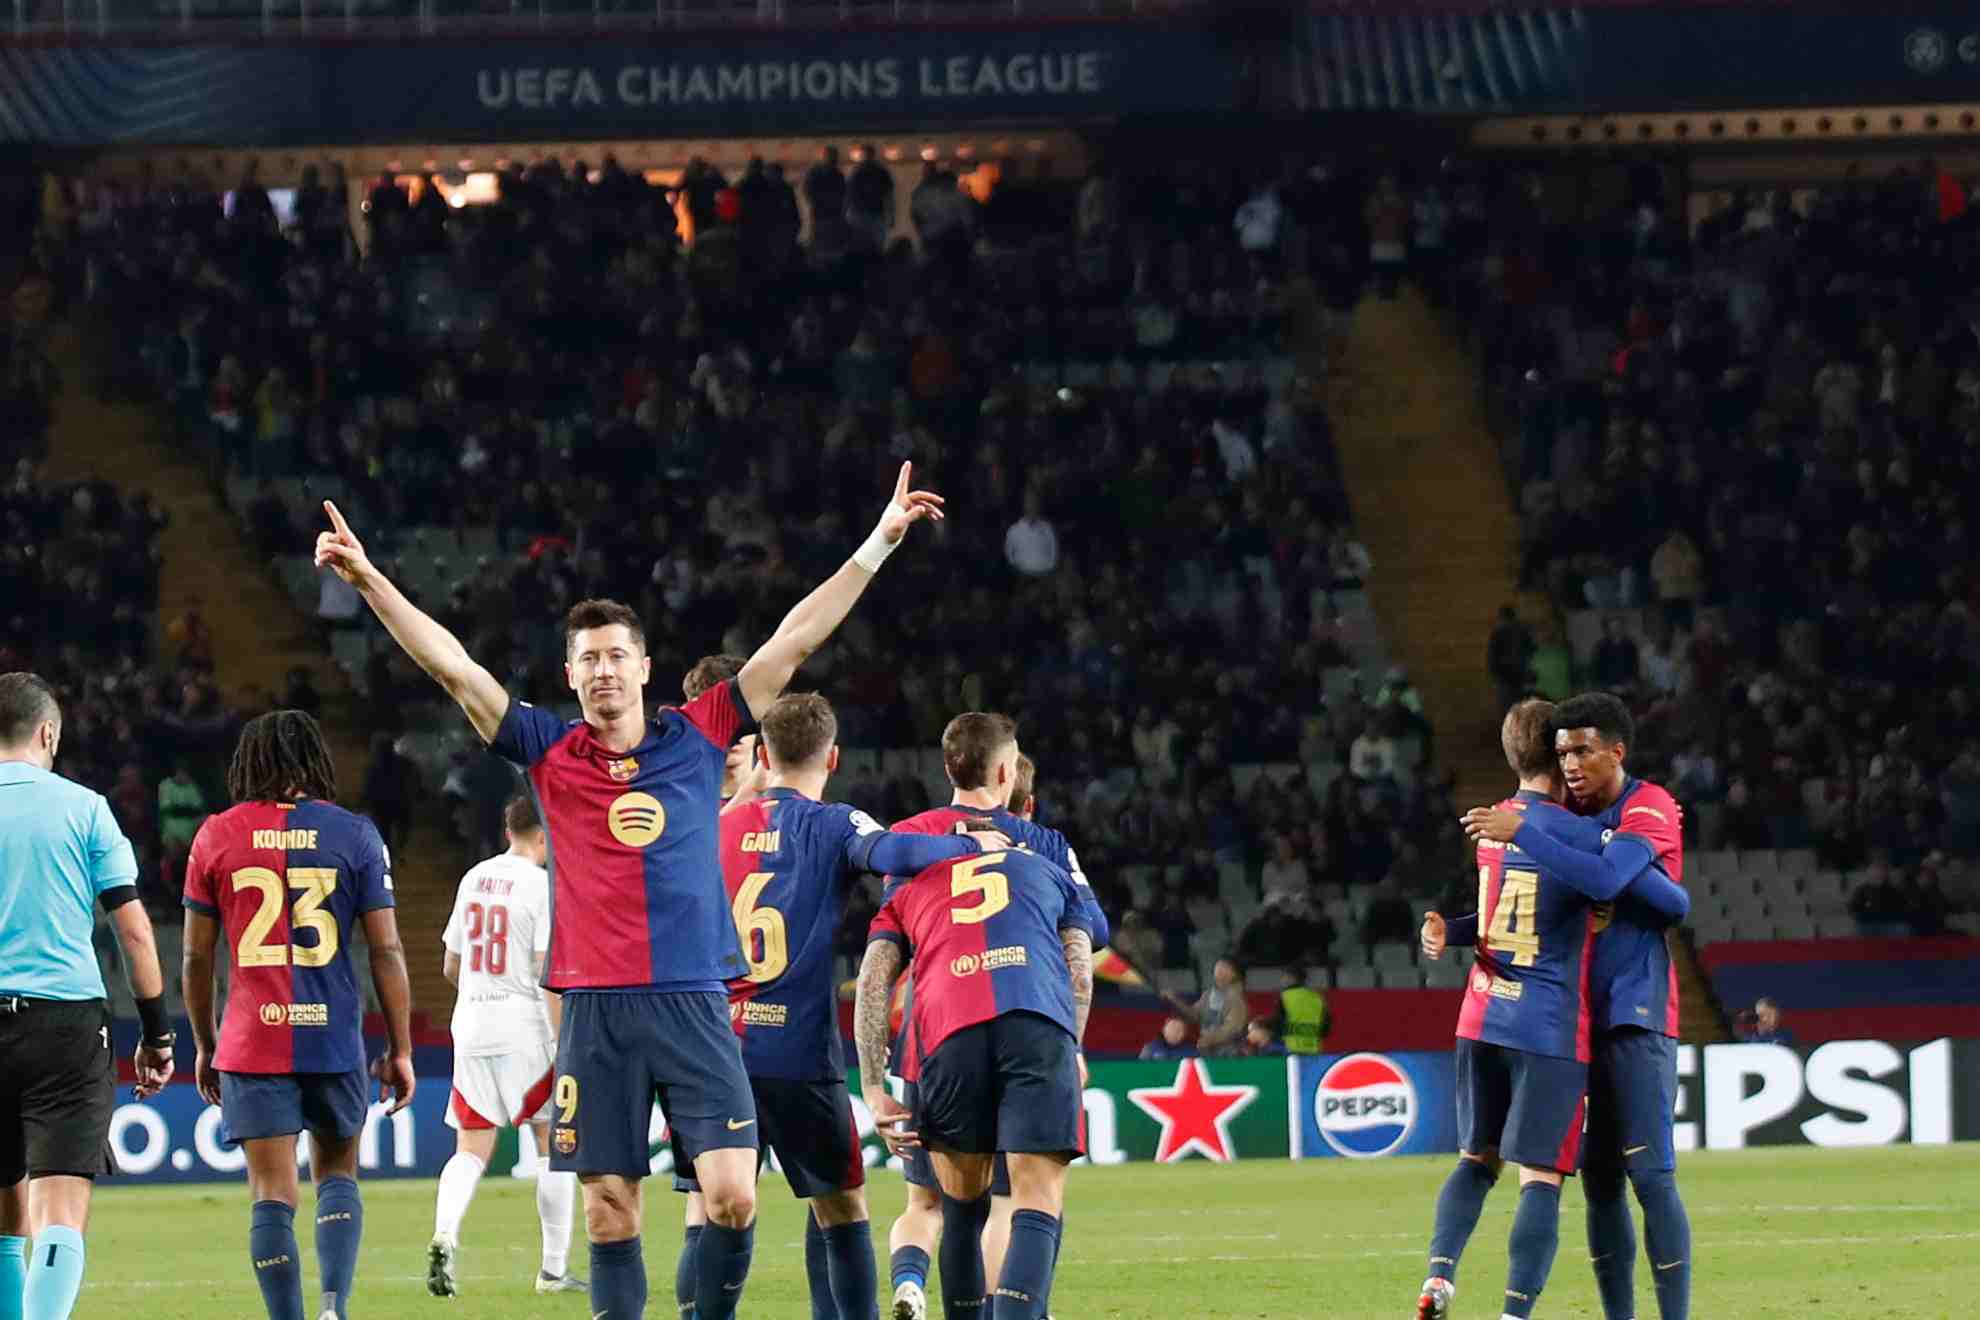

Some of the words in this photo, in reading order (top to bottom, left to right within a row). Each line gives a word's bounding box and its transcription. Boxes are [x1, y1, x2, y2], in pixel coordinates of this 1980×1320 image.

[476, 67, 602, 107] UEFA
[616, 59, 898, 105] CHAMPIONS
[919, 53, 1100, 94] LEAGUE
[253, 829, 318, 849] KOUNDE
[741, 830, 780, 852] GAVI
[950, 851, 1010, 924] 5
[231, 866, 339, 967] 23
[465, 902, 508, 975] 28
[732, 872, 789, 983] 6
[1478, 864, 1540, 967] 14
[742, 1011, 787, 1023] ACNUR
[743, 1001, 787, 1014] UNHCR
[556, 1074, 577, 1123] 9
[1324, 1096, 1407, 1117] PEPSI
